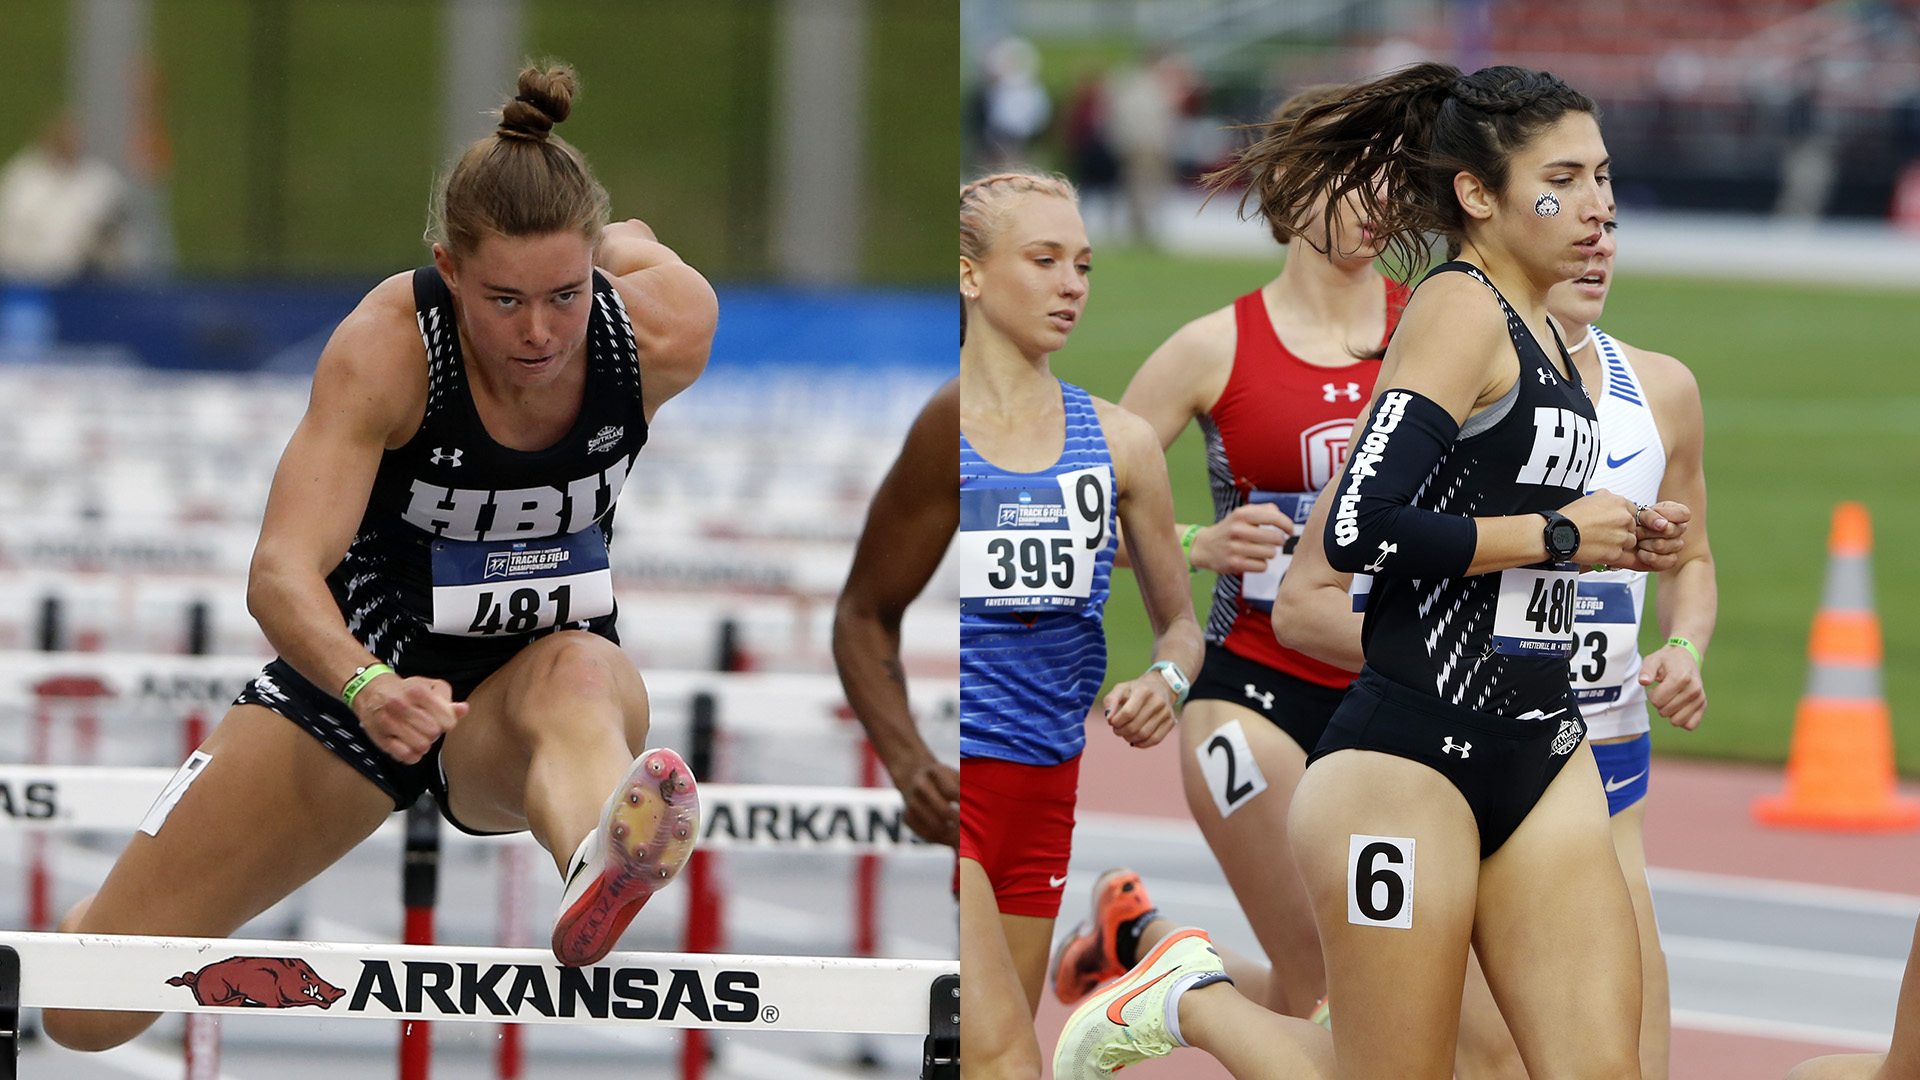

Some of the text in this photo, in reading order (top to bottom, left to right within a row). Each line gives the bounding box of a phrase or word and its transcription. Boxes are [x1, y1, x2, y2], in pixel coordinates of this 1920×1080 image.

[402, 454, 630, 542] HBU
[1335, 391, 1413, 547] HUSKIES
[1076, 474, 1104, 549] 9
[511, 554, 539, 566] TRACK
[547, 551, 570, 563] FIELD
[987, 537, 1075, 590] 395
[468, 585, 571, 635] 481
[1525, 577, 1575, 635] 480
[1208, 736, 1253, 805] 2
[705, 804, 921, 844] ARKAN
[1355, 842, 1405, 921] 6
[348, 959, 760, 1023] ARKANSAS
